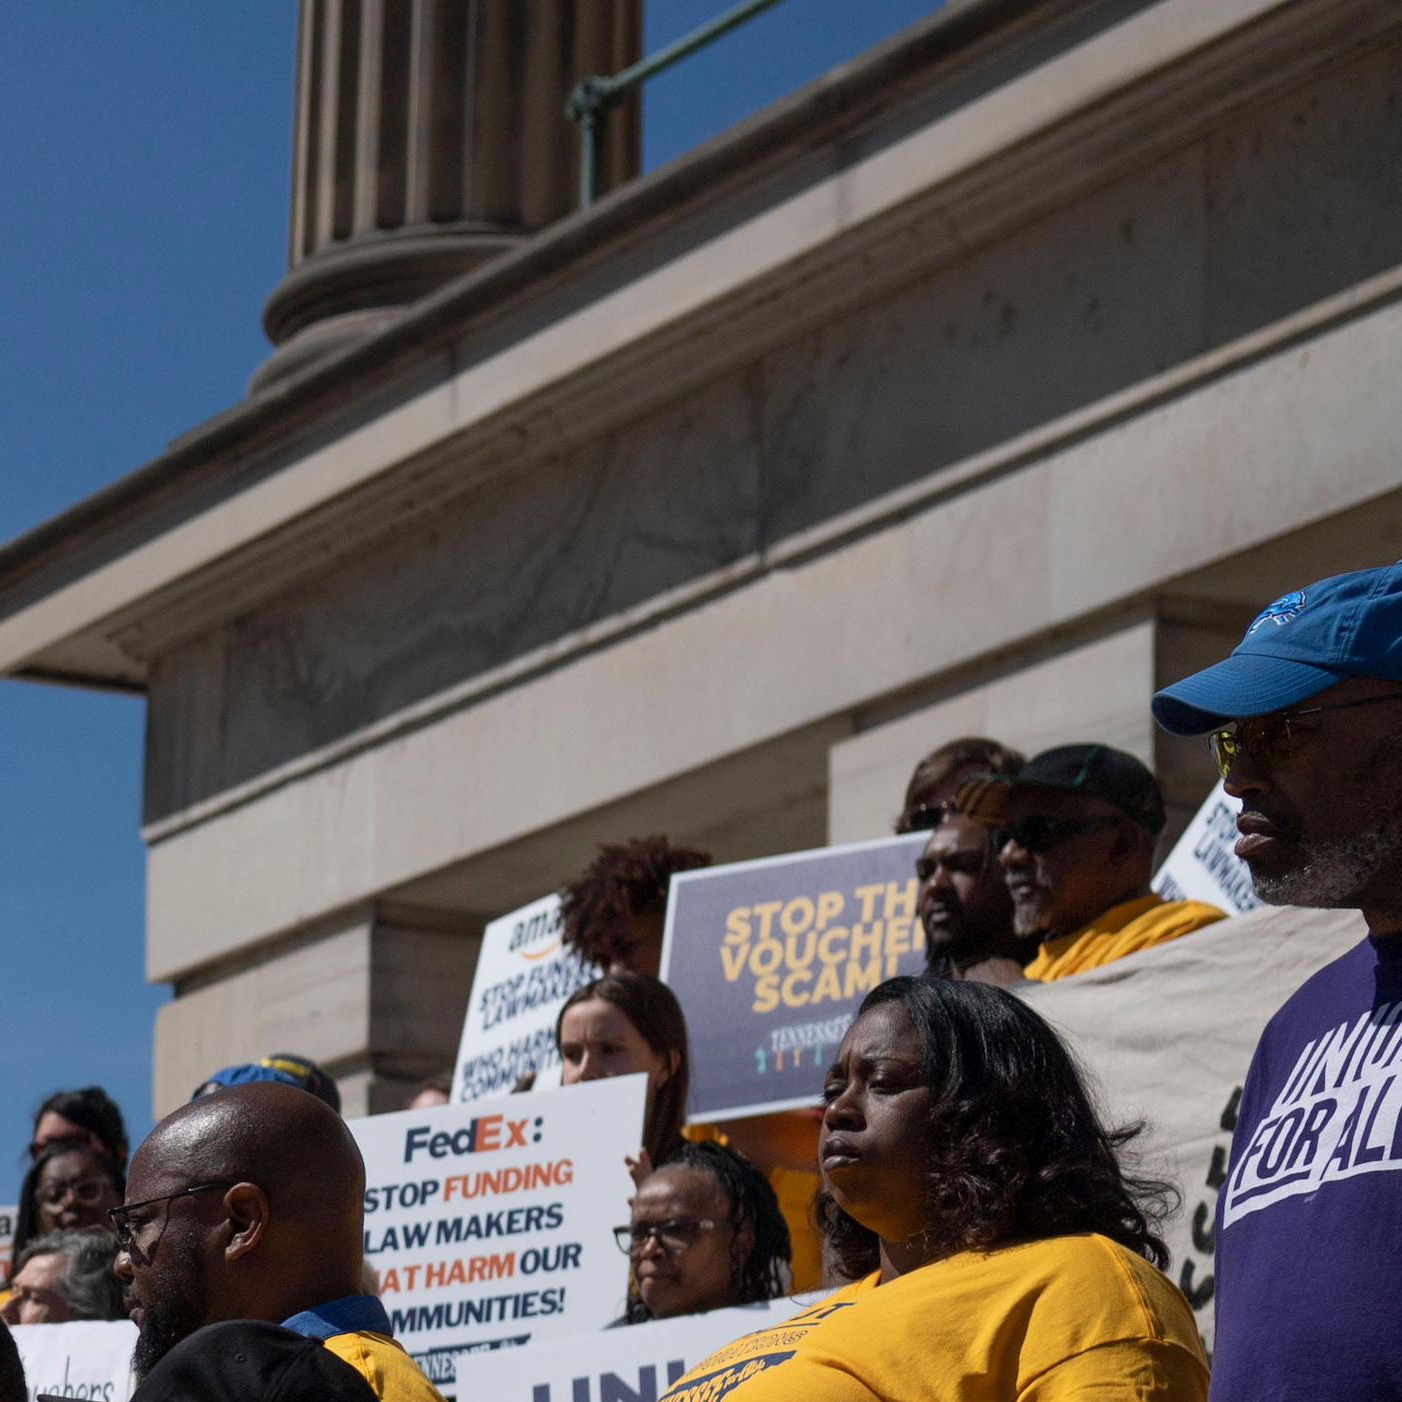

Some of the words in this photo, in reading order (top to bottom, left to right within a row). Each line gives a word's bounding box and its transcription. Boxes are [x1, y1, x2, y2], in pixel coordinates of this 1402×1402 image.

[722, 891, 846, 946] STOP
[404, 1114, 544, 1164] FedEx:
[1233, 1097, 1338, 1193] FOR
[364, 1179, 439, 1214] STOP
[443, 1159, 574, 1203] FUNDING
[425, 1252, 516, 1290] HARM
[519, 1242, 583, 1276] OUR
